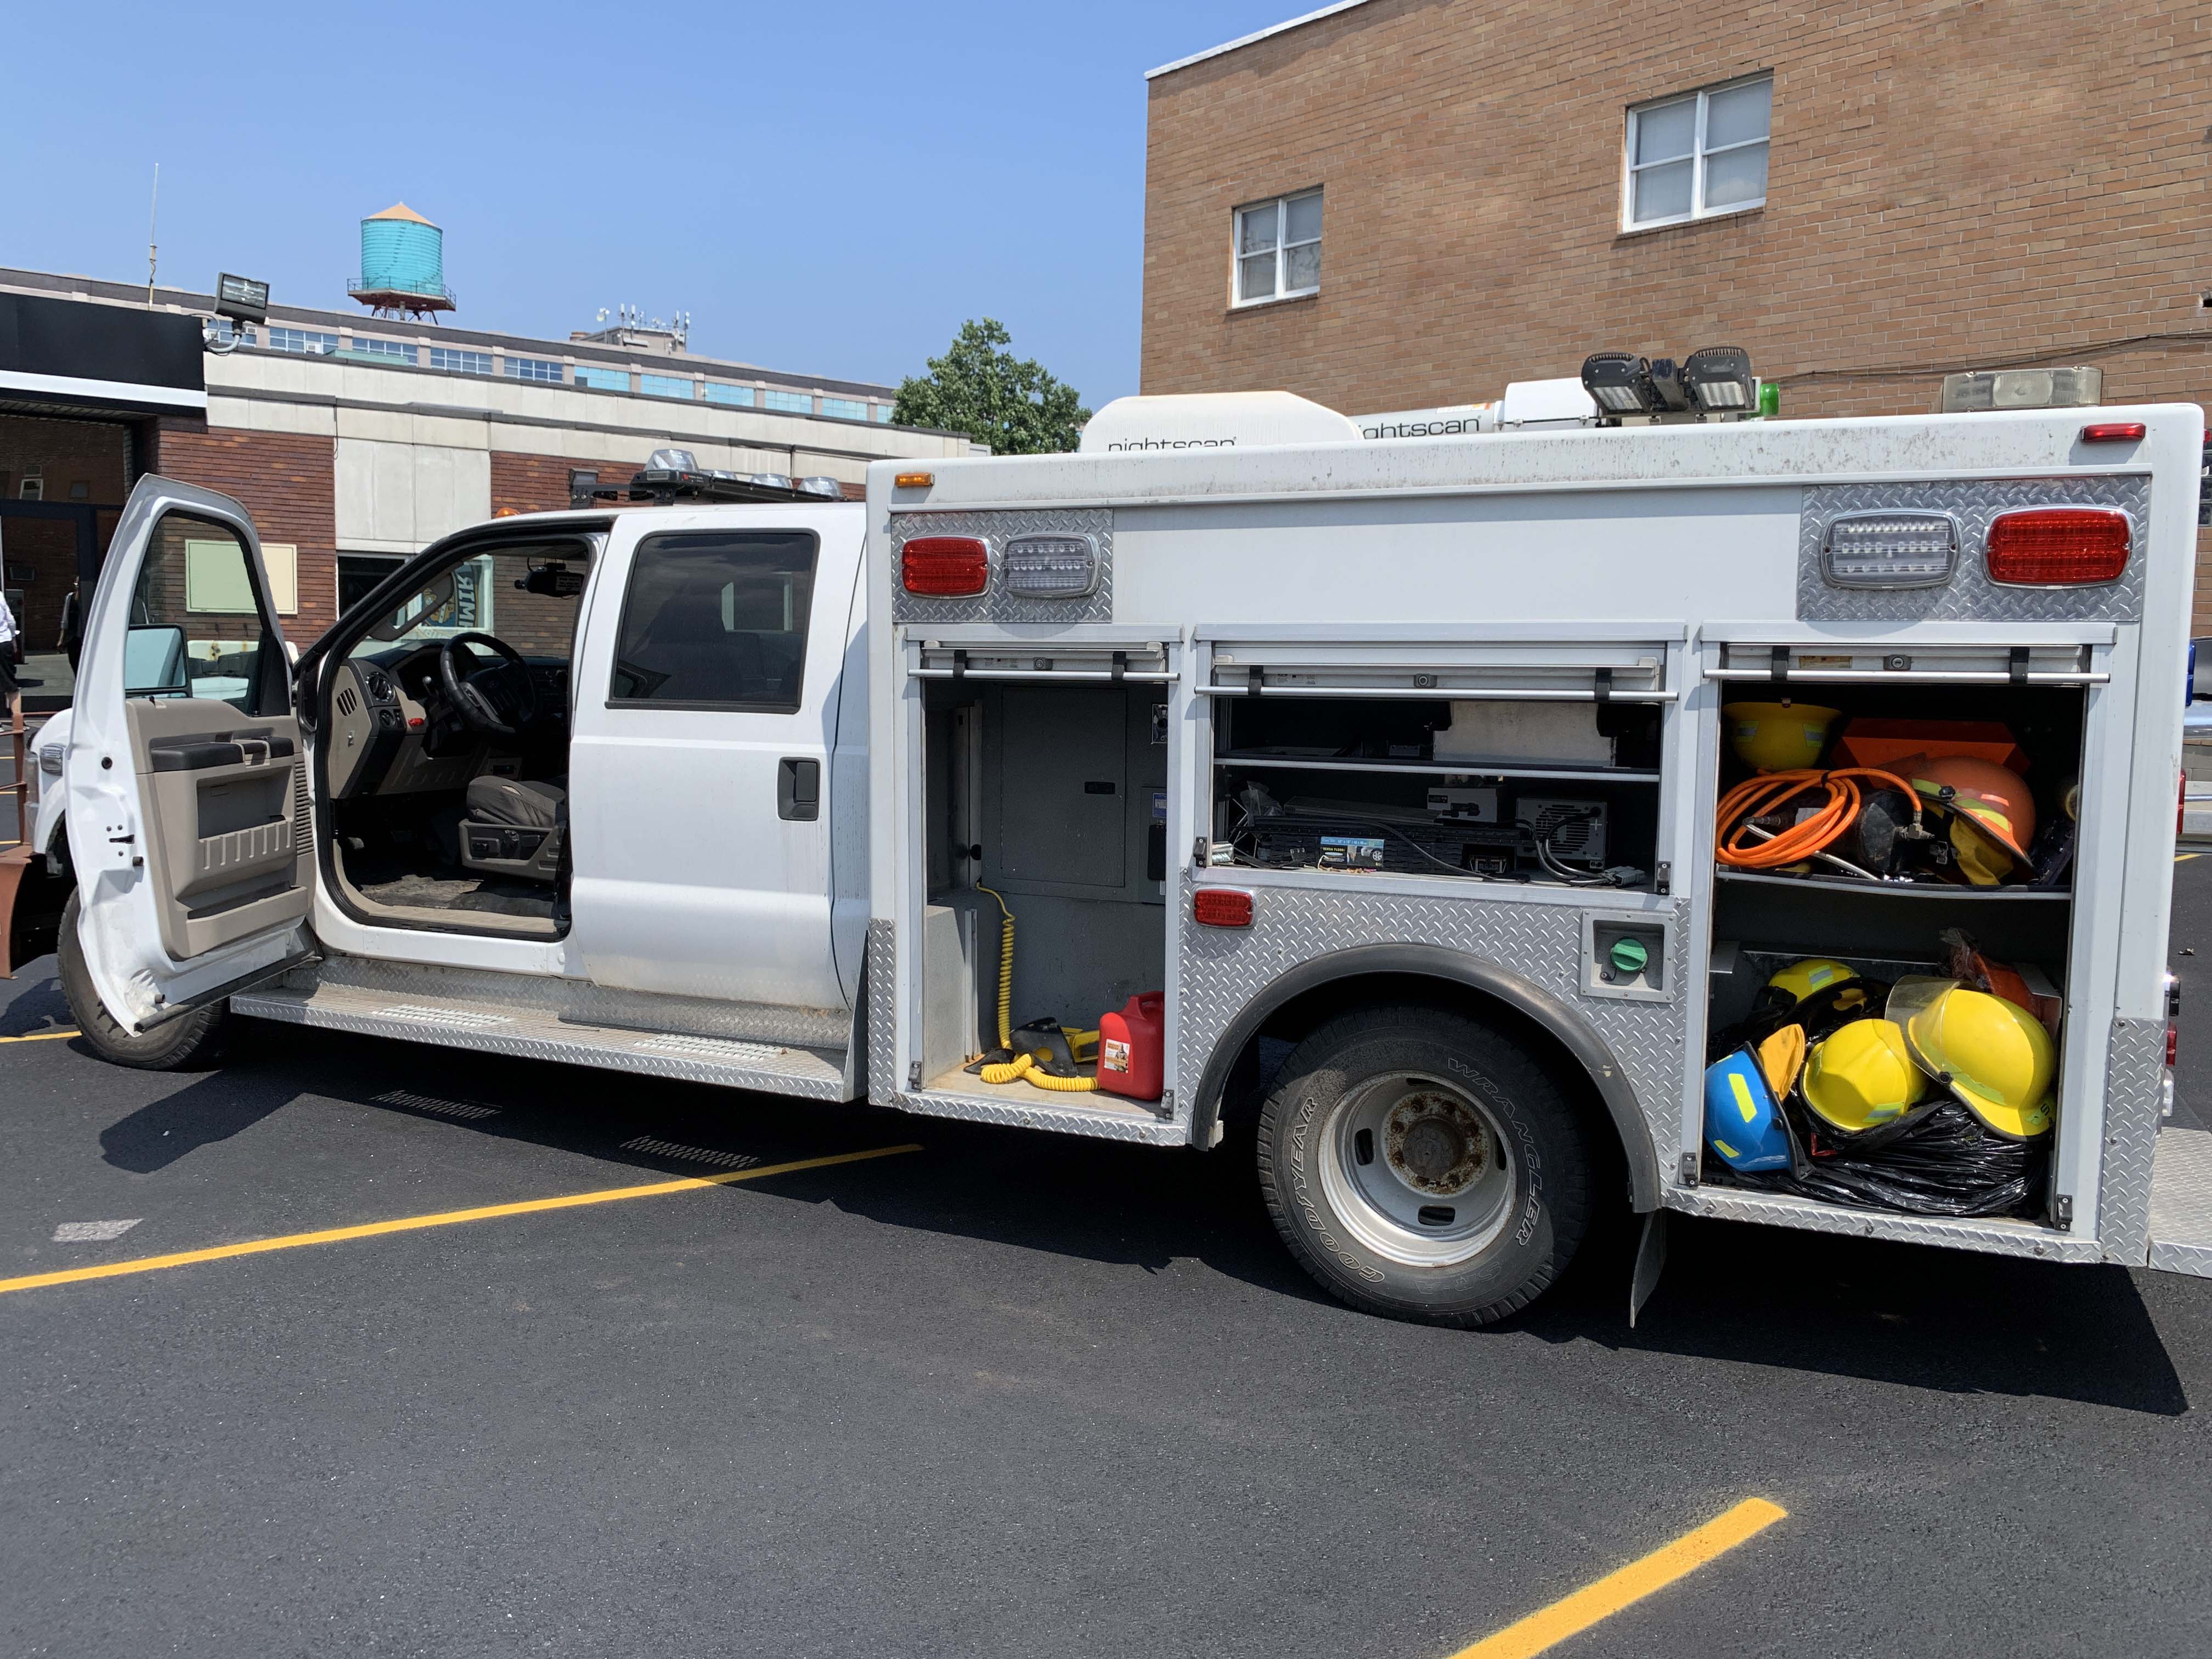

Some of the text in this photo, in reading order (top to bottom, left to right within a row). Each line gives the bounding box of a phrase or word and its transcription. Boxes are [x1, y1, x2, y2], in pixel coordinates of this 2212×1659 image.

[1359, 417, 1480, 439] ghtscan
[1290, 1097, 1385, 1283] GOODYEAR
[1447, 1057, 1543, 1246] WRANGLER
